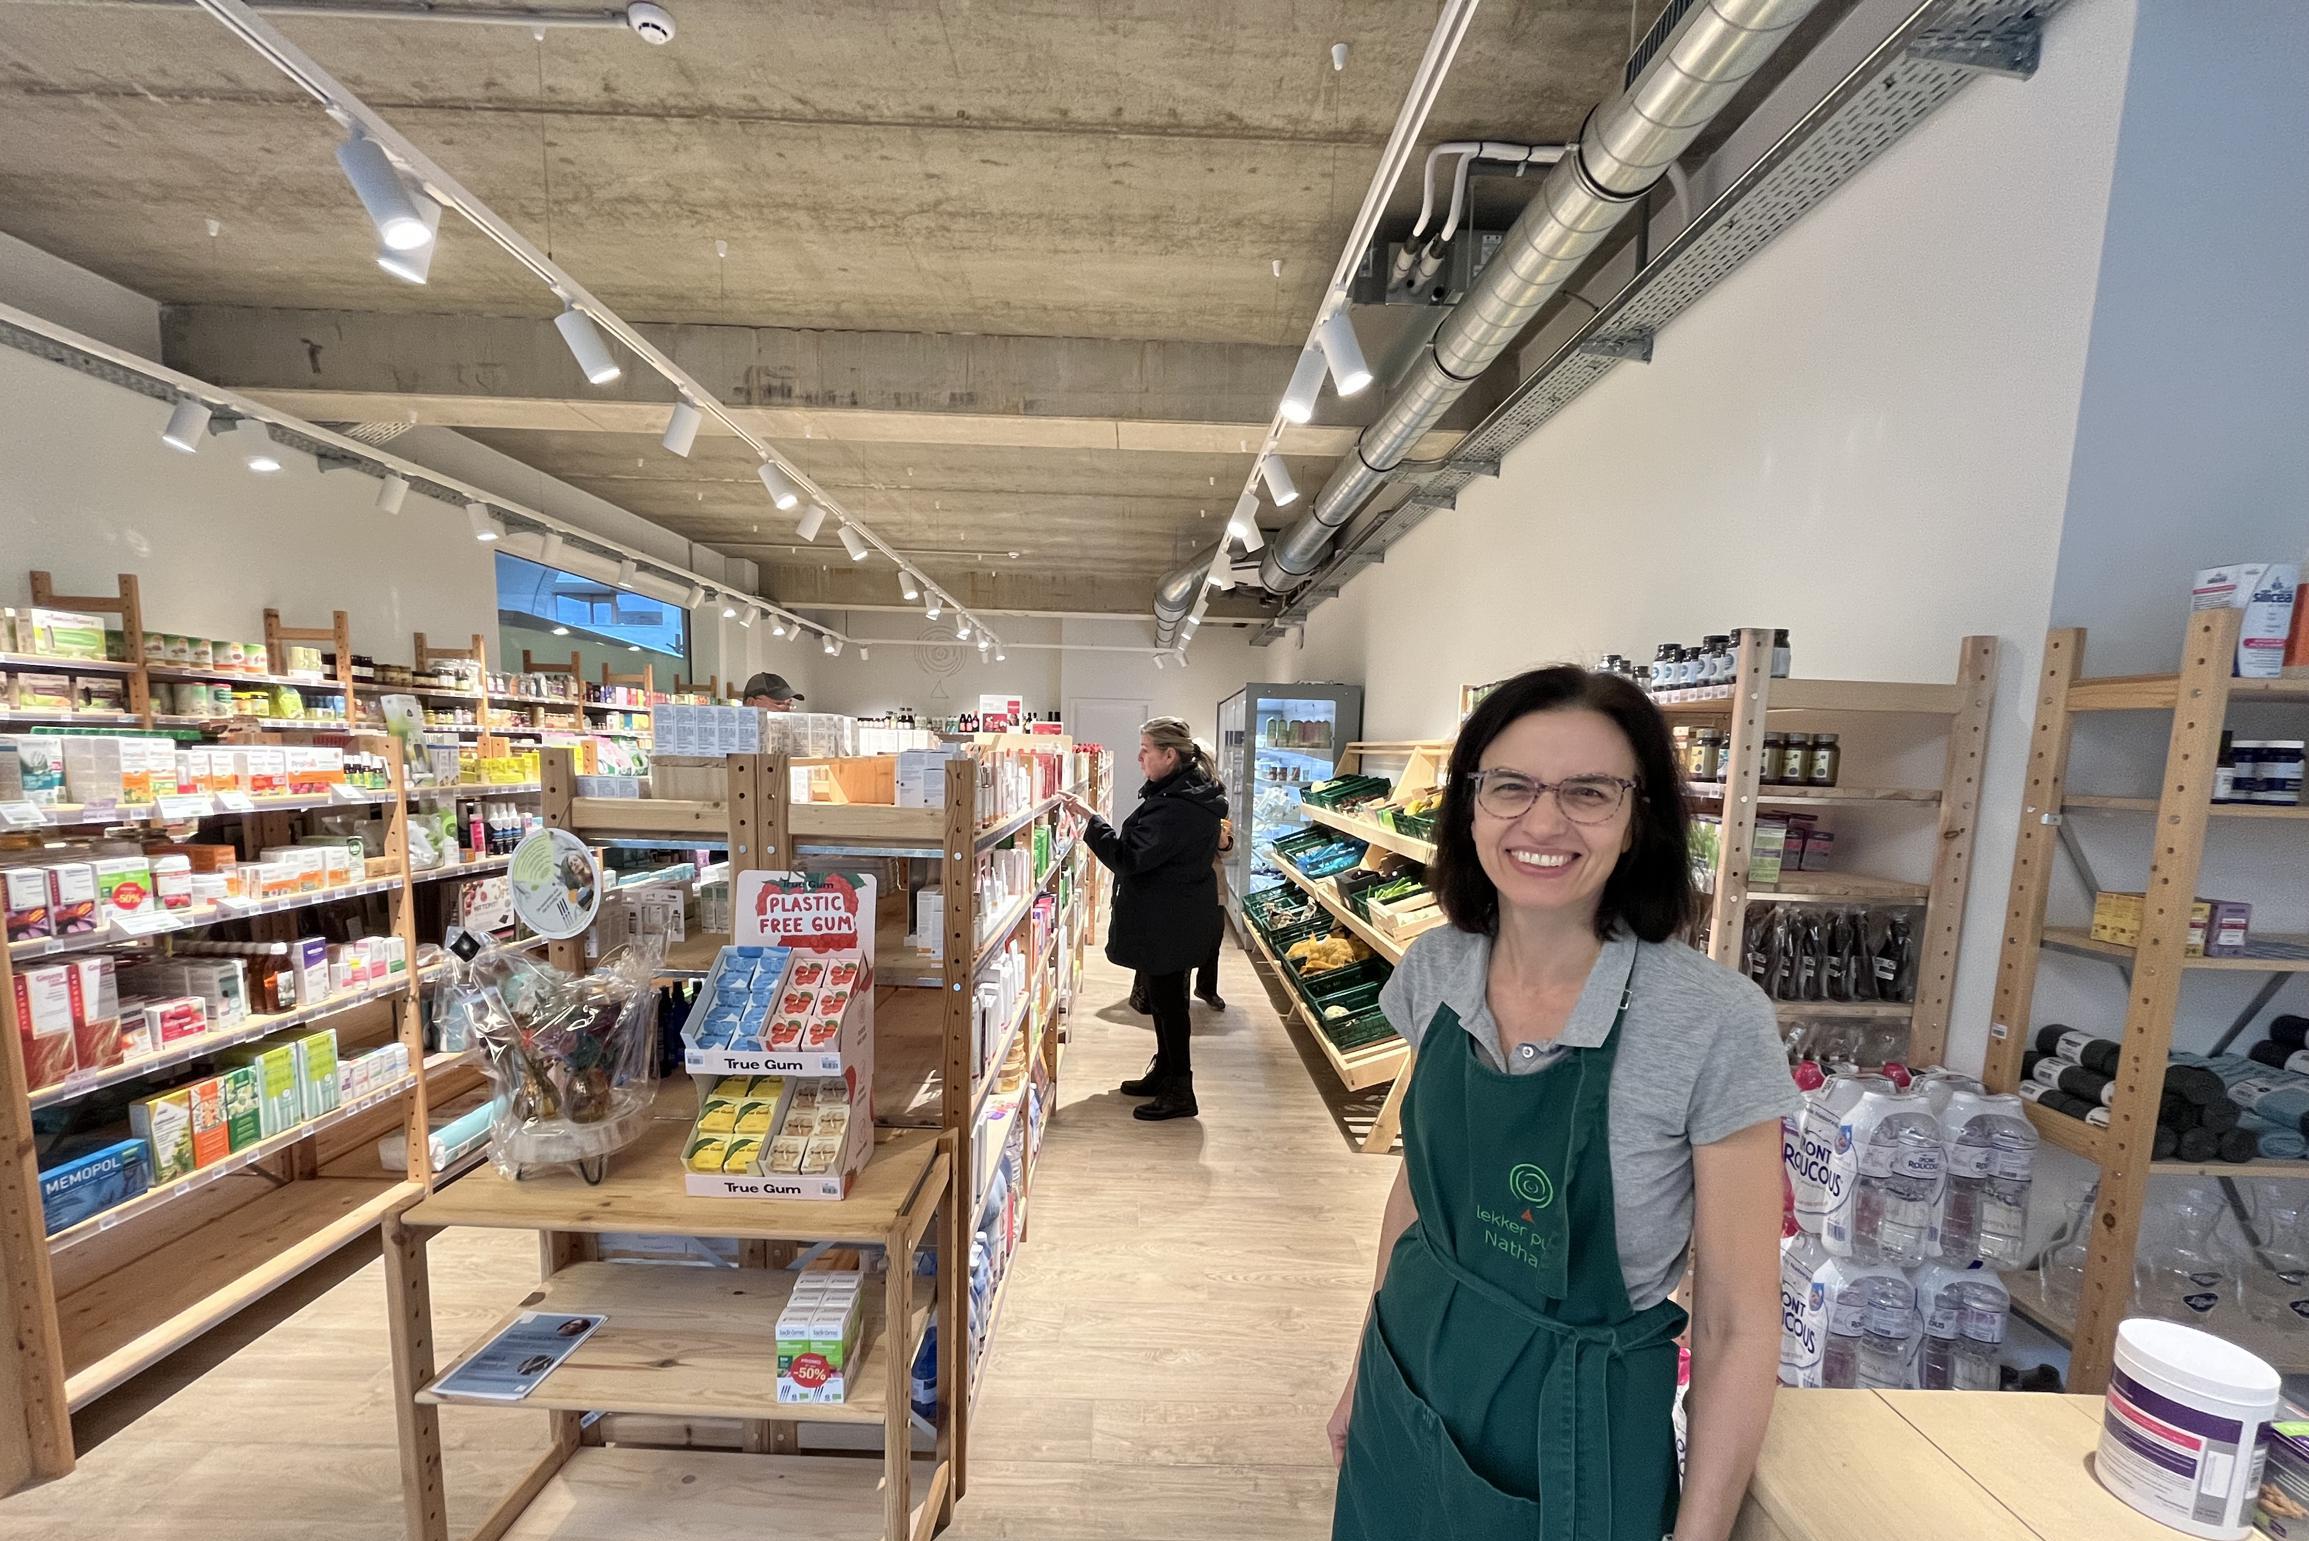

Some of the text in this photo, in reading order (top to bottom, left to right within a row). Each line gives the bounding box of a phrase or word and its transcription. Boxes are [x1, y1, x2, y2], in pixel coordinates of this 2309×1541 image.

[782, 880, 834, 889] True Gum
[769, 895, 842, 914] PLASTIC
[760, 916, 852, 934] FREE GUM
[724, 1058, 803, 1071] True Gum
[45, 1157, 121, 1196] MEMOPOL
[724, 1182, 802, 1195] True Gum
[1476, 1204, 1528, 1237] lekker
[1782, 1291, 1807, 1318] ONT
[793, 1367, 826, 1381] -50%
